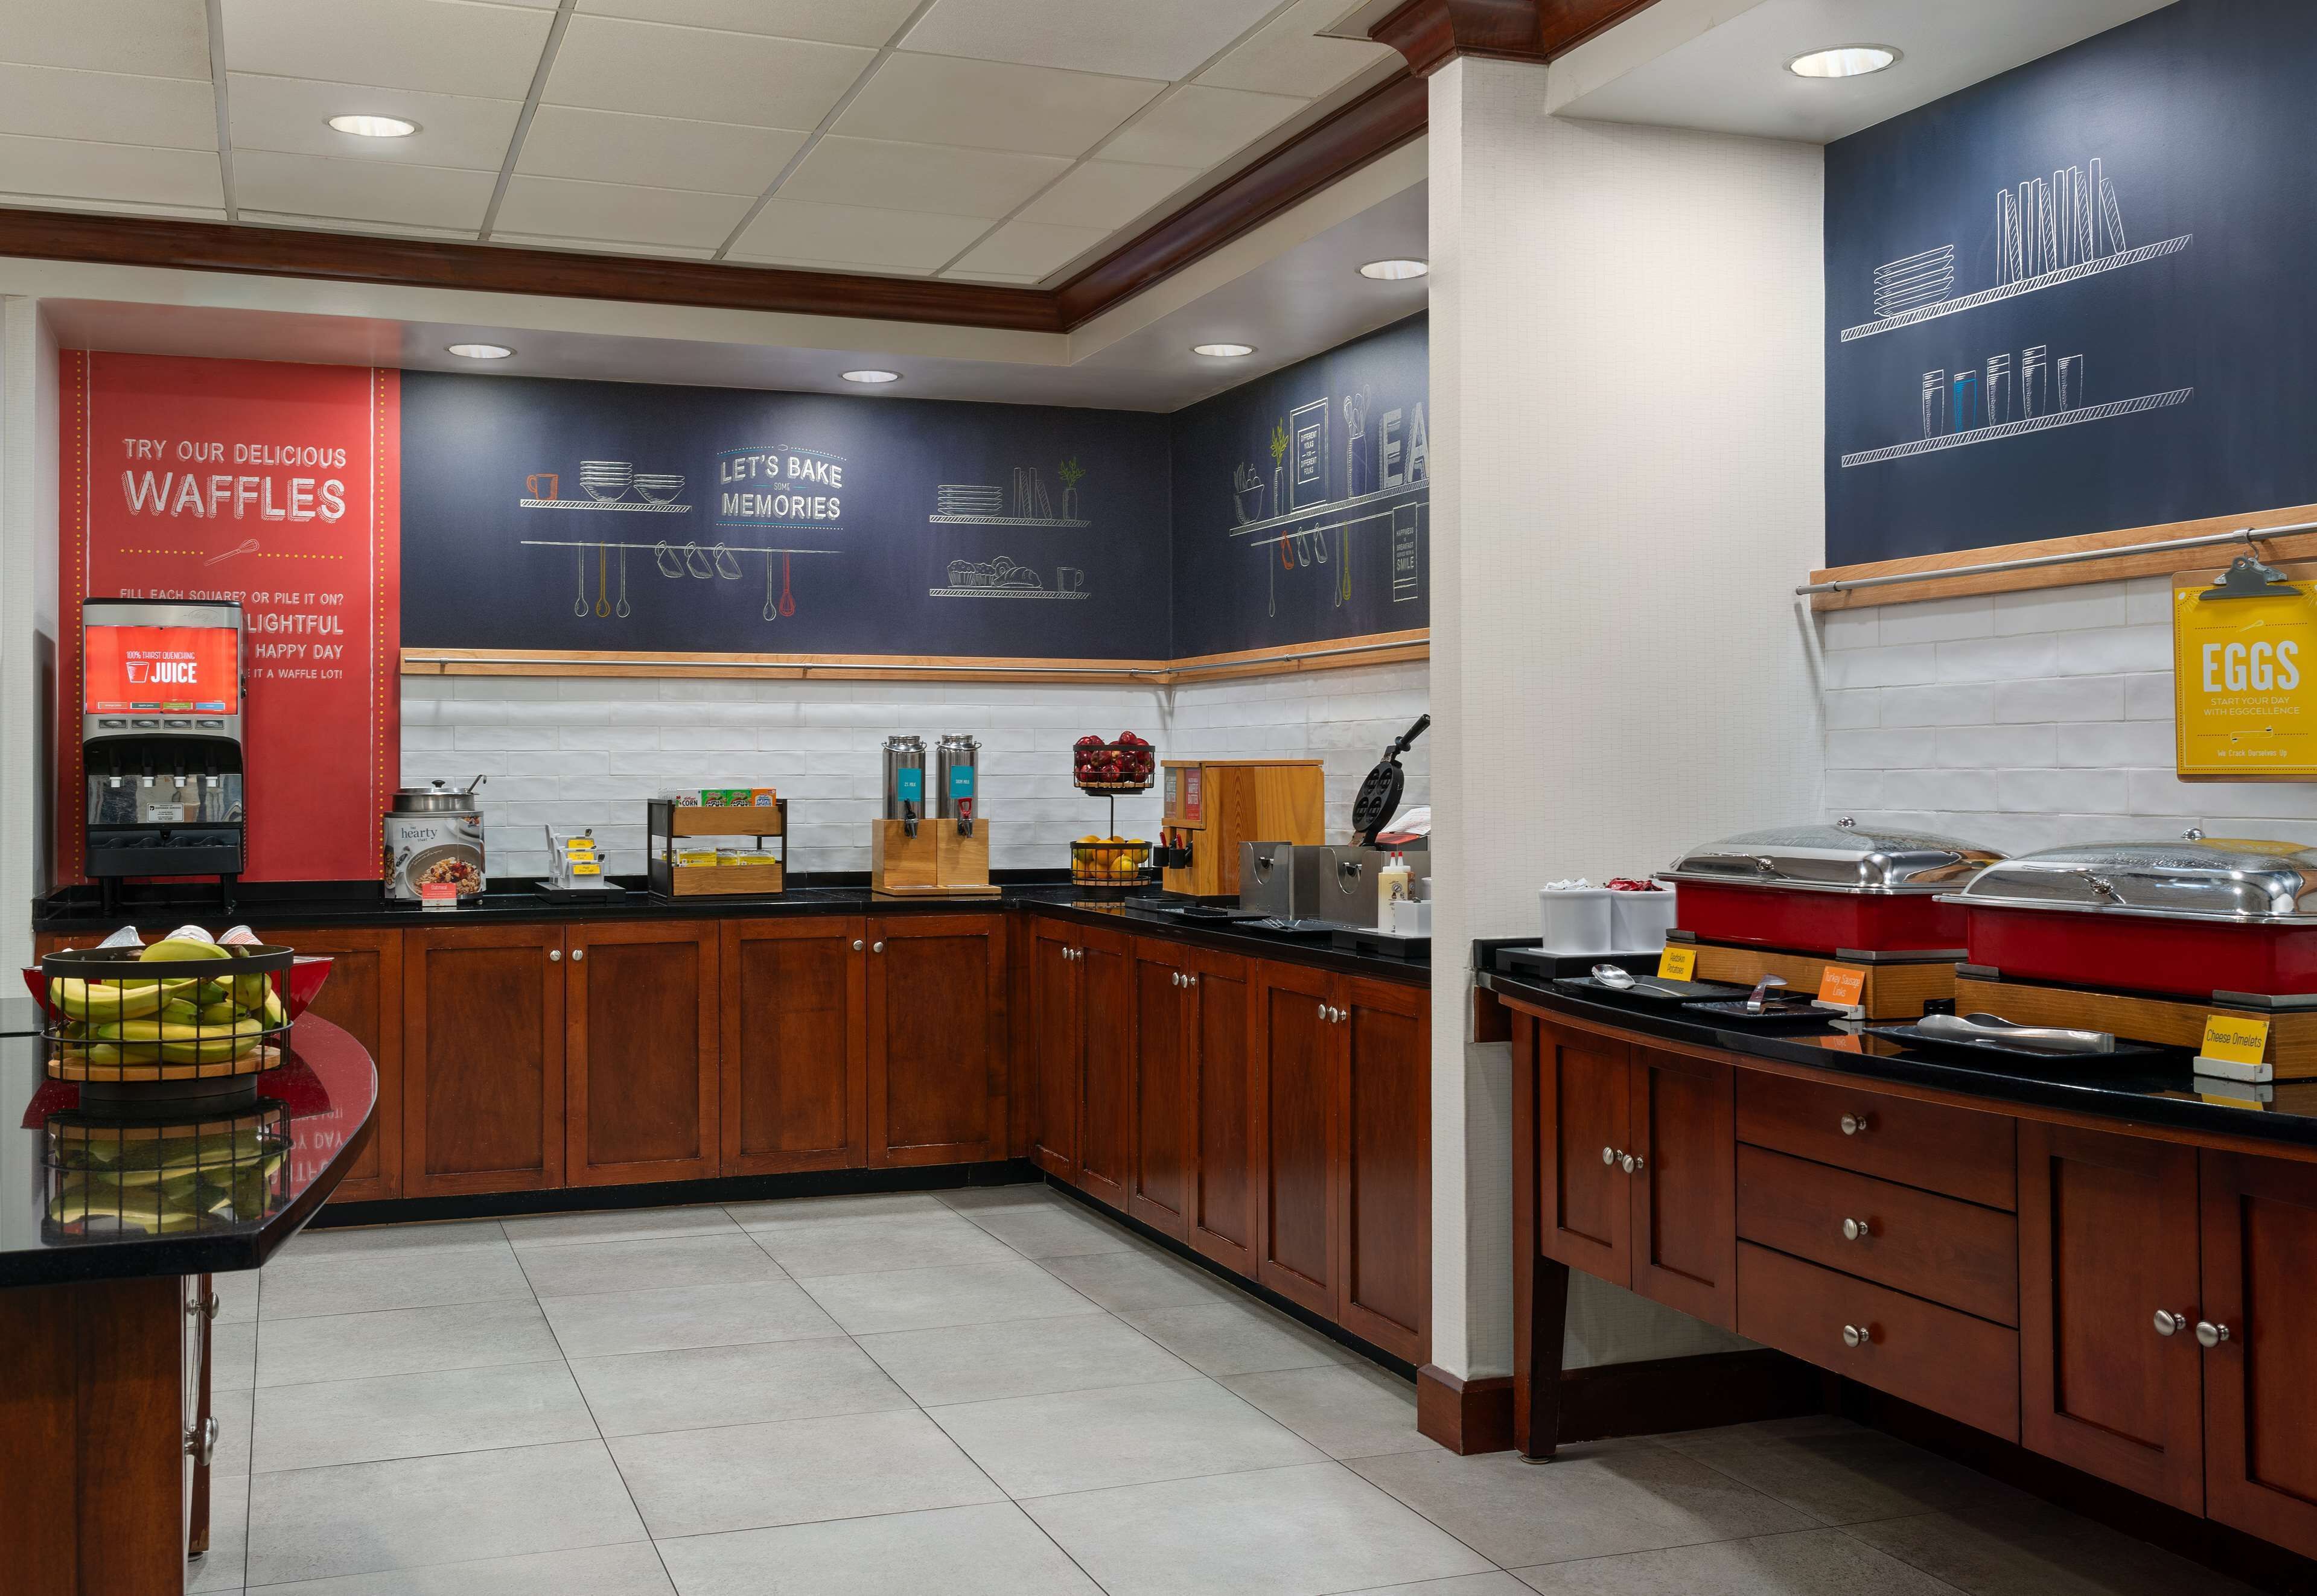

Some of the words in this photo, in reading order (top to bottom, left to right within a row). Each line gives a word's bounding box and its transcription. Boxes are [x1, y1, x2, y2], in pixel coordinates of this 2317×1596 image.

[1301, 431, 1317, 442] DIFFERENT
[1304, 440, 1313, 449] YOLKS
[1379, 402, 1430, 491] EA
[123, 439, 167, 460] TRY
[177, 440, 224, 463] OUR
[234, 445, 346, 469] DELICIOUS
[1301, 457, 1317, 468] DIFFERENT
[721, 456, 779, 484] LET'S
[787, 457, 843, 489] BAKE
[1304, 466, 1313, 475] FOLKS
[121, 471, 346, 524] WAFFLES
[721, 493, 841, 520] MEMORIES
[1397, 556, 1414, 571] SMILE
[121, 589, 144, 599] FILL
[151, 590, 183, 599] EACH
[190, 591, 246, 602] SQUARE?
[251, 592, 269, 603] OR
[275, 593, 299, 605] PILE
[304, 594, 315, 605] IT
[320, 594, 343, 605] ON?
[256, 644, 307, 658] HAPPY
[313, 644, 343, 659] DAY
[151, 662, 197, 683] JUICE
[254, 669, 263, 678] IT
[267, 669, 274, 678] A
[278, 669, 317, 679] WAFFLE
[321, 670, 342, 679] LOT!
[2203, 641, 2300, 692] EGGS
[2229, 707, 2301, 716] EGGCELLENCE
[2279, 749, 2287, 757] Up
[401, 828, 438, 839] hearty
[1667, 964, 1684, 974] Potatoes
[1825, 971, 1840, 985] Turkey
[1842, 974, 1860, 988] Sausage
[1833, 986, 1846, 997] Links
[2207, 1029, 2231, 1043] Cheese
[2233, 1032, 2262, 1048] Omelets
